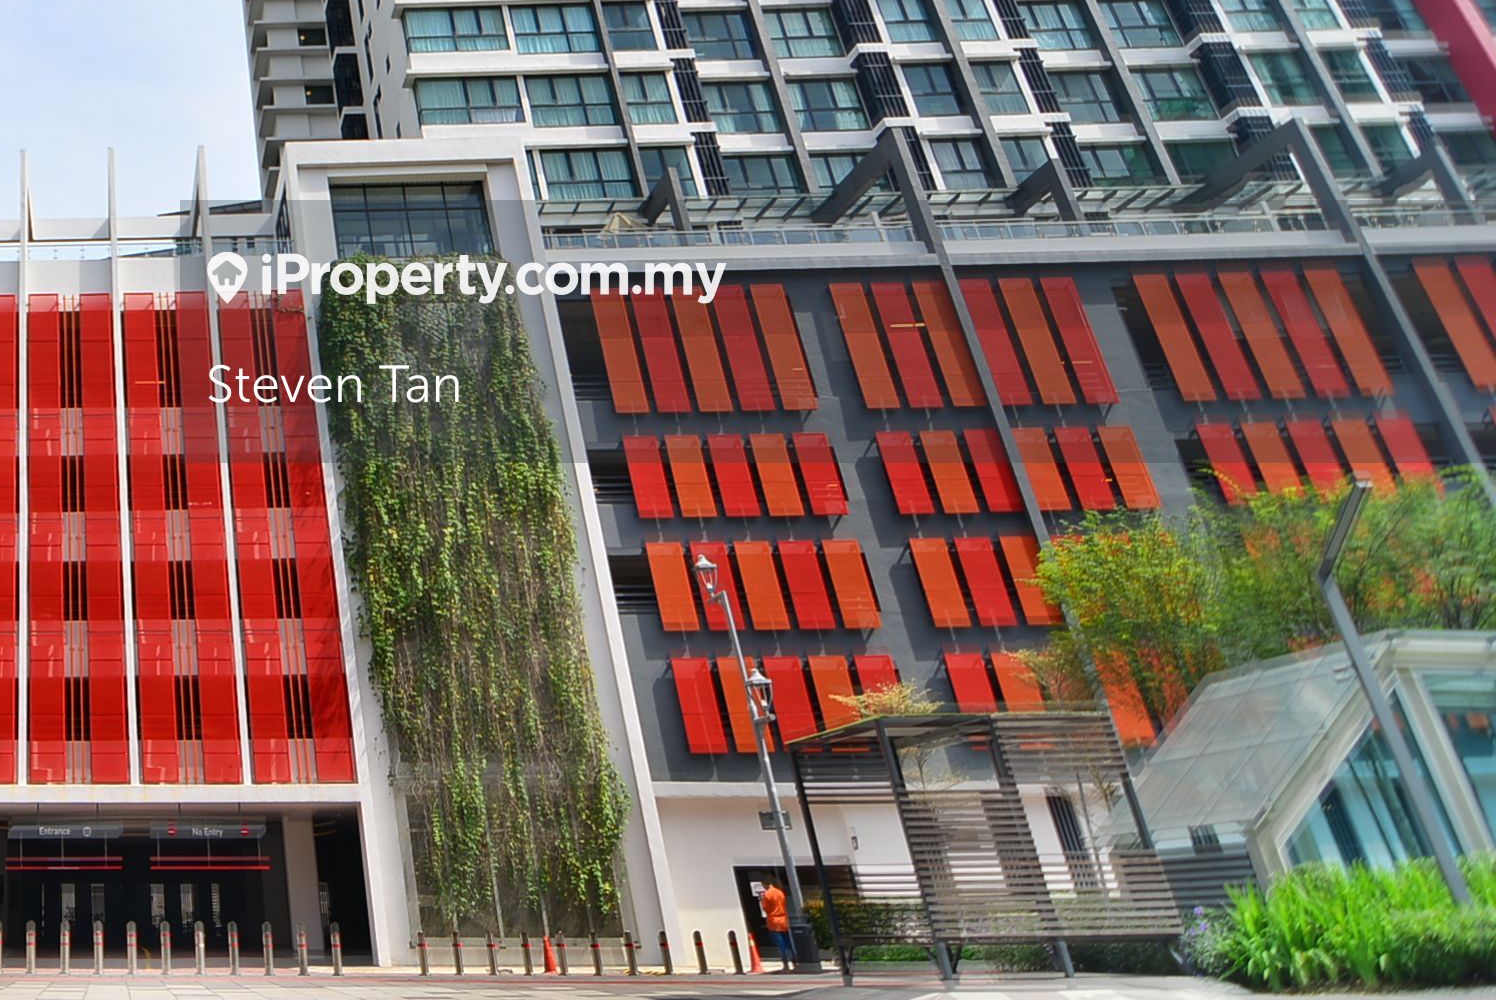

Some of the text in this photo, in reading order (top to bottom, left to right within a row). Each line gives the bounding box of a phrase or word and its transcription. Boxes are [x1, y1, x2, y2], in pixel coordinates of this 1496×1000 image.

[39, 826, 71, 836] Entrance
[192, 827, 224, 839] No Entry
